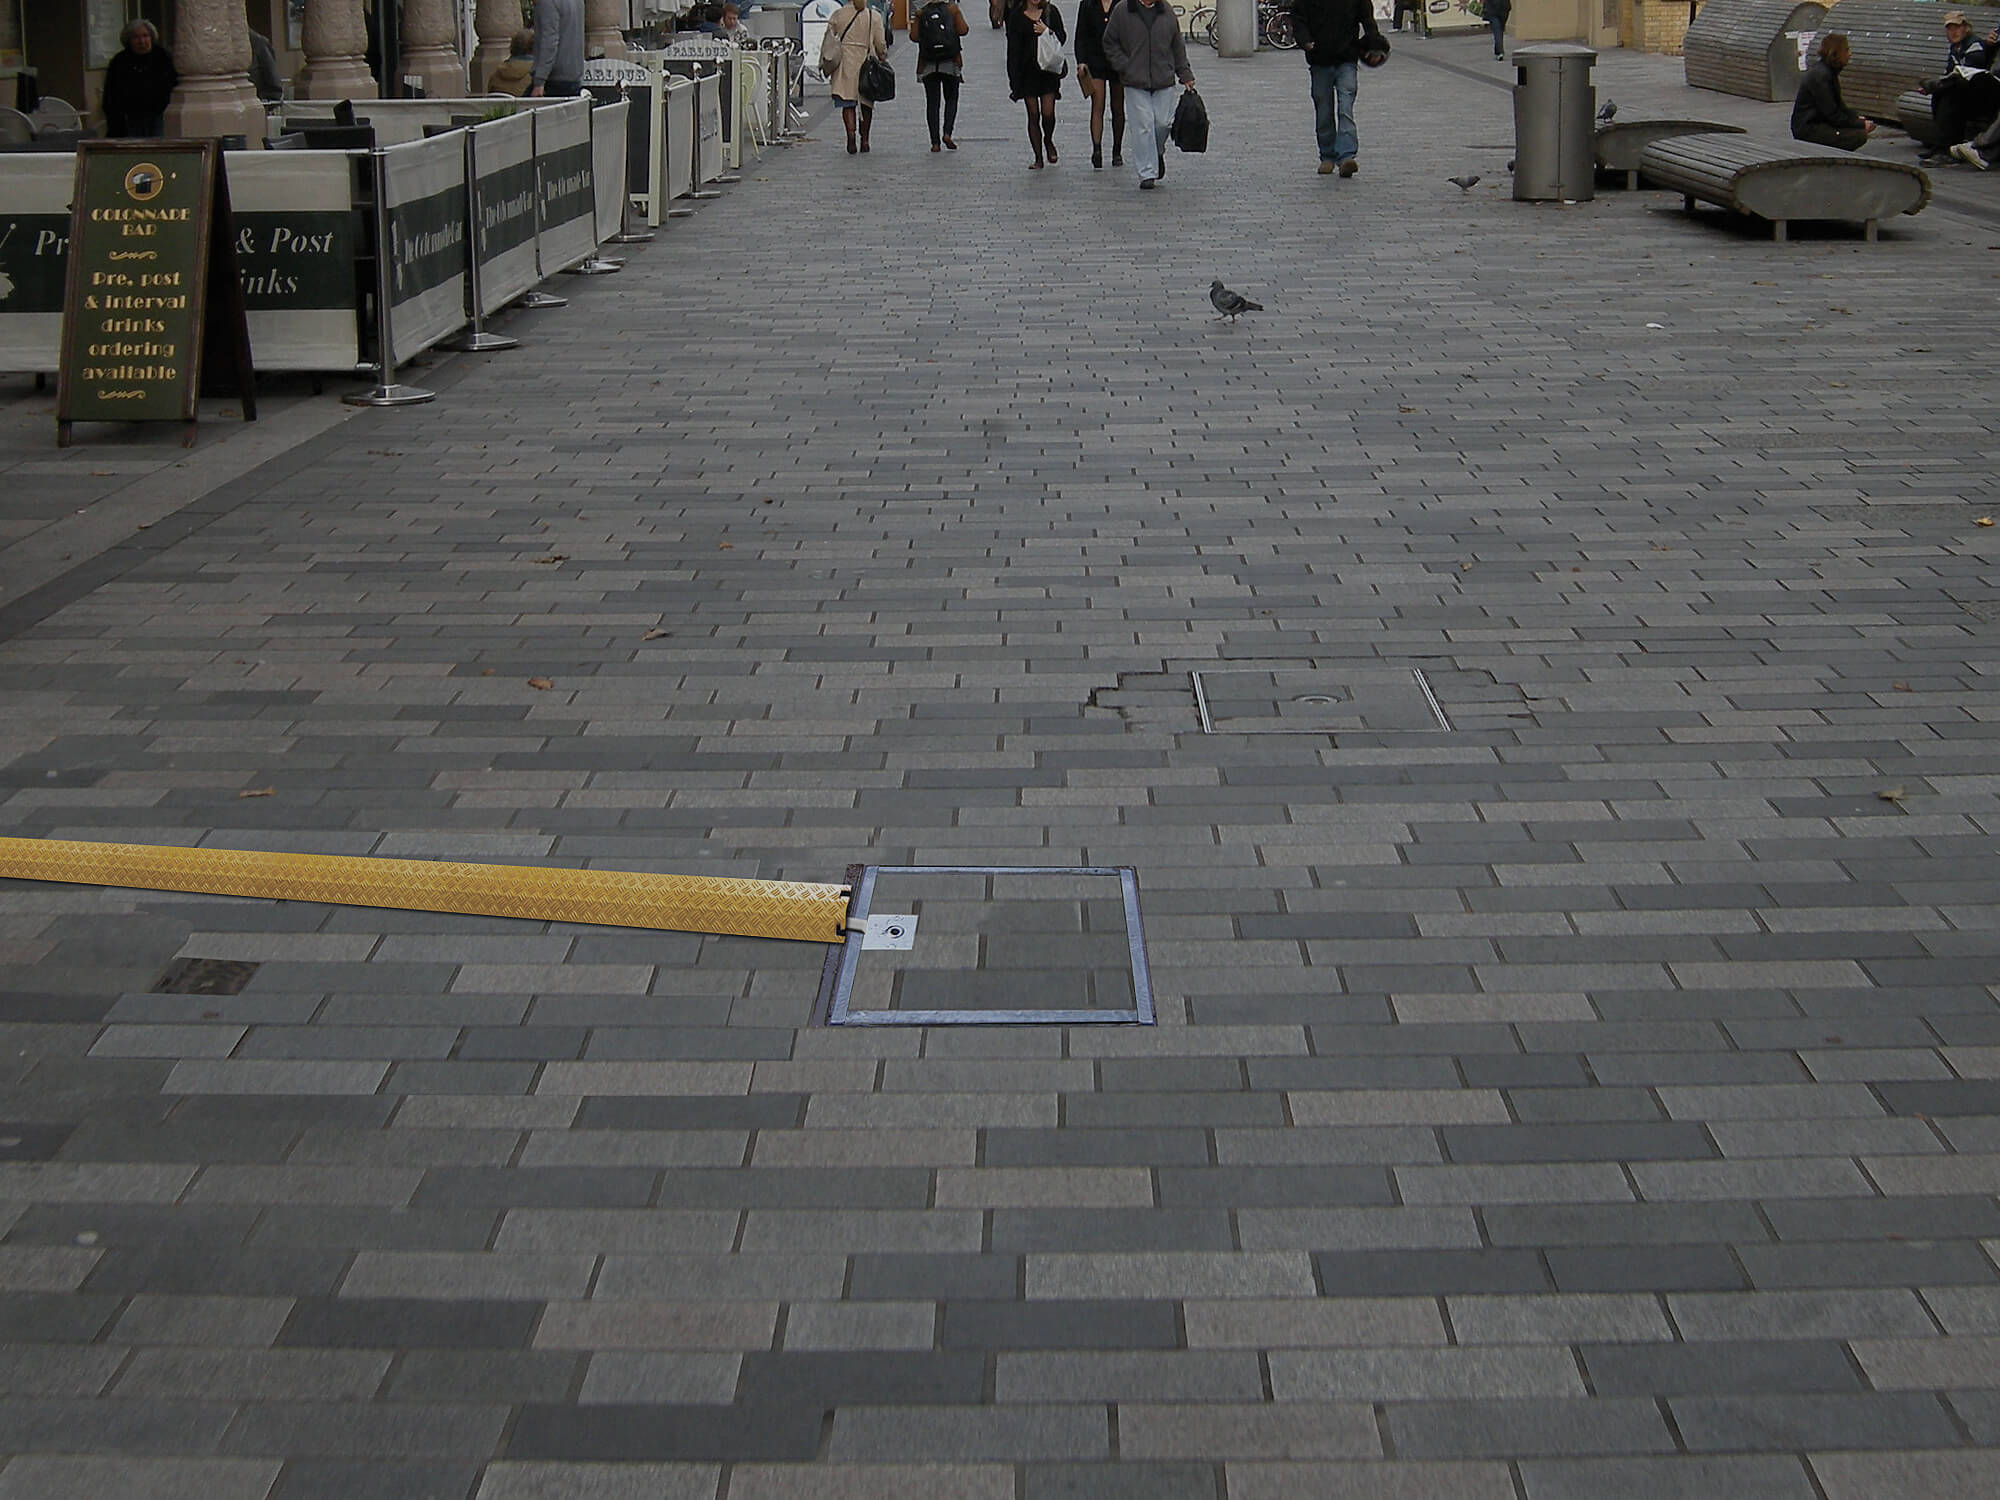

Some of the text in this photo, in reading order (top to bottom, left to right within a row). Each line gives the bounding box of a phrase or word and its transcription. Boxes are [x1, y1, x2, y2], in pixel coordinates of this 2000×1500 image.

[673, 47, 728, 57] PARLOUR
[583, 68, 647, 81] ARLOUR
[91, 208, 191, 221] COLONNADE
[122, 224, 157, 236] BAR
[34, 227, 334, 256] Pr & Post
[140, 271, 180, 288] post
[239, 268, 298, 295] inks
[85, 295, 186, 309] & interval
[101, 319, 165, 332] drinks
[88, 342, 175, 357] ordering
[82, 366, 177, 380] available
